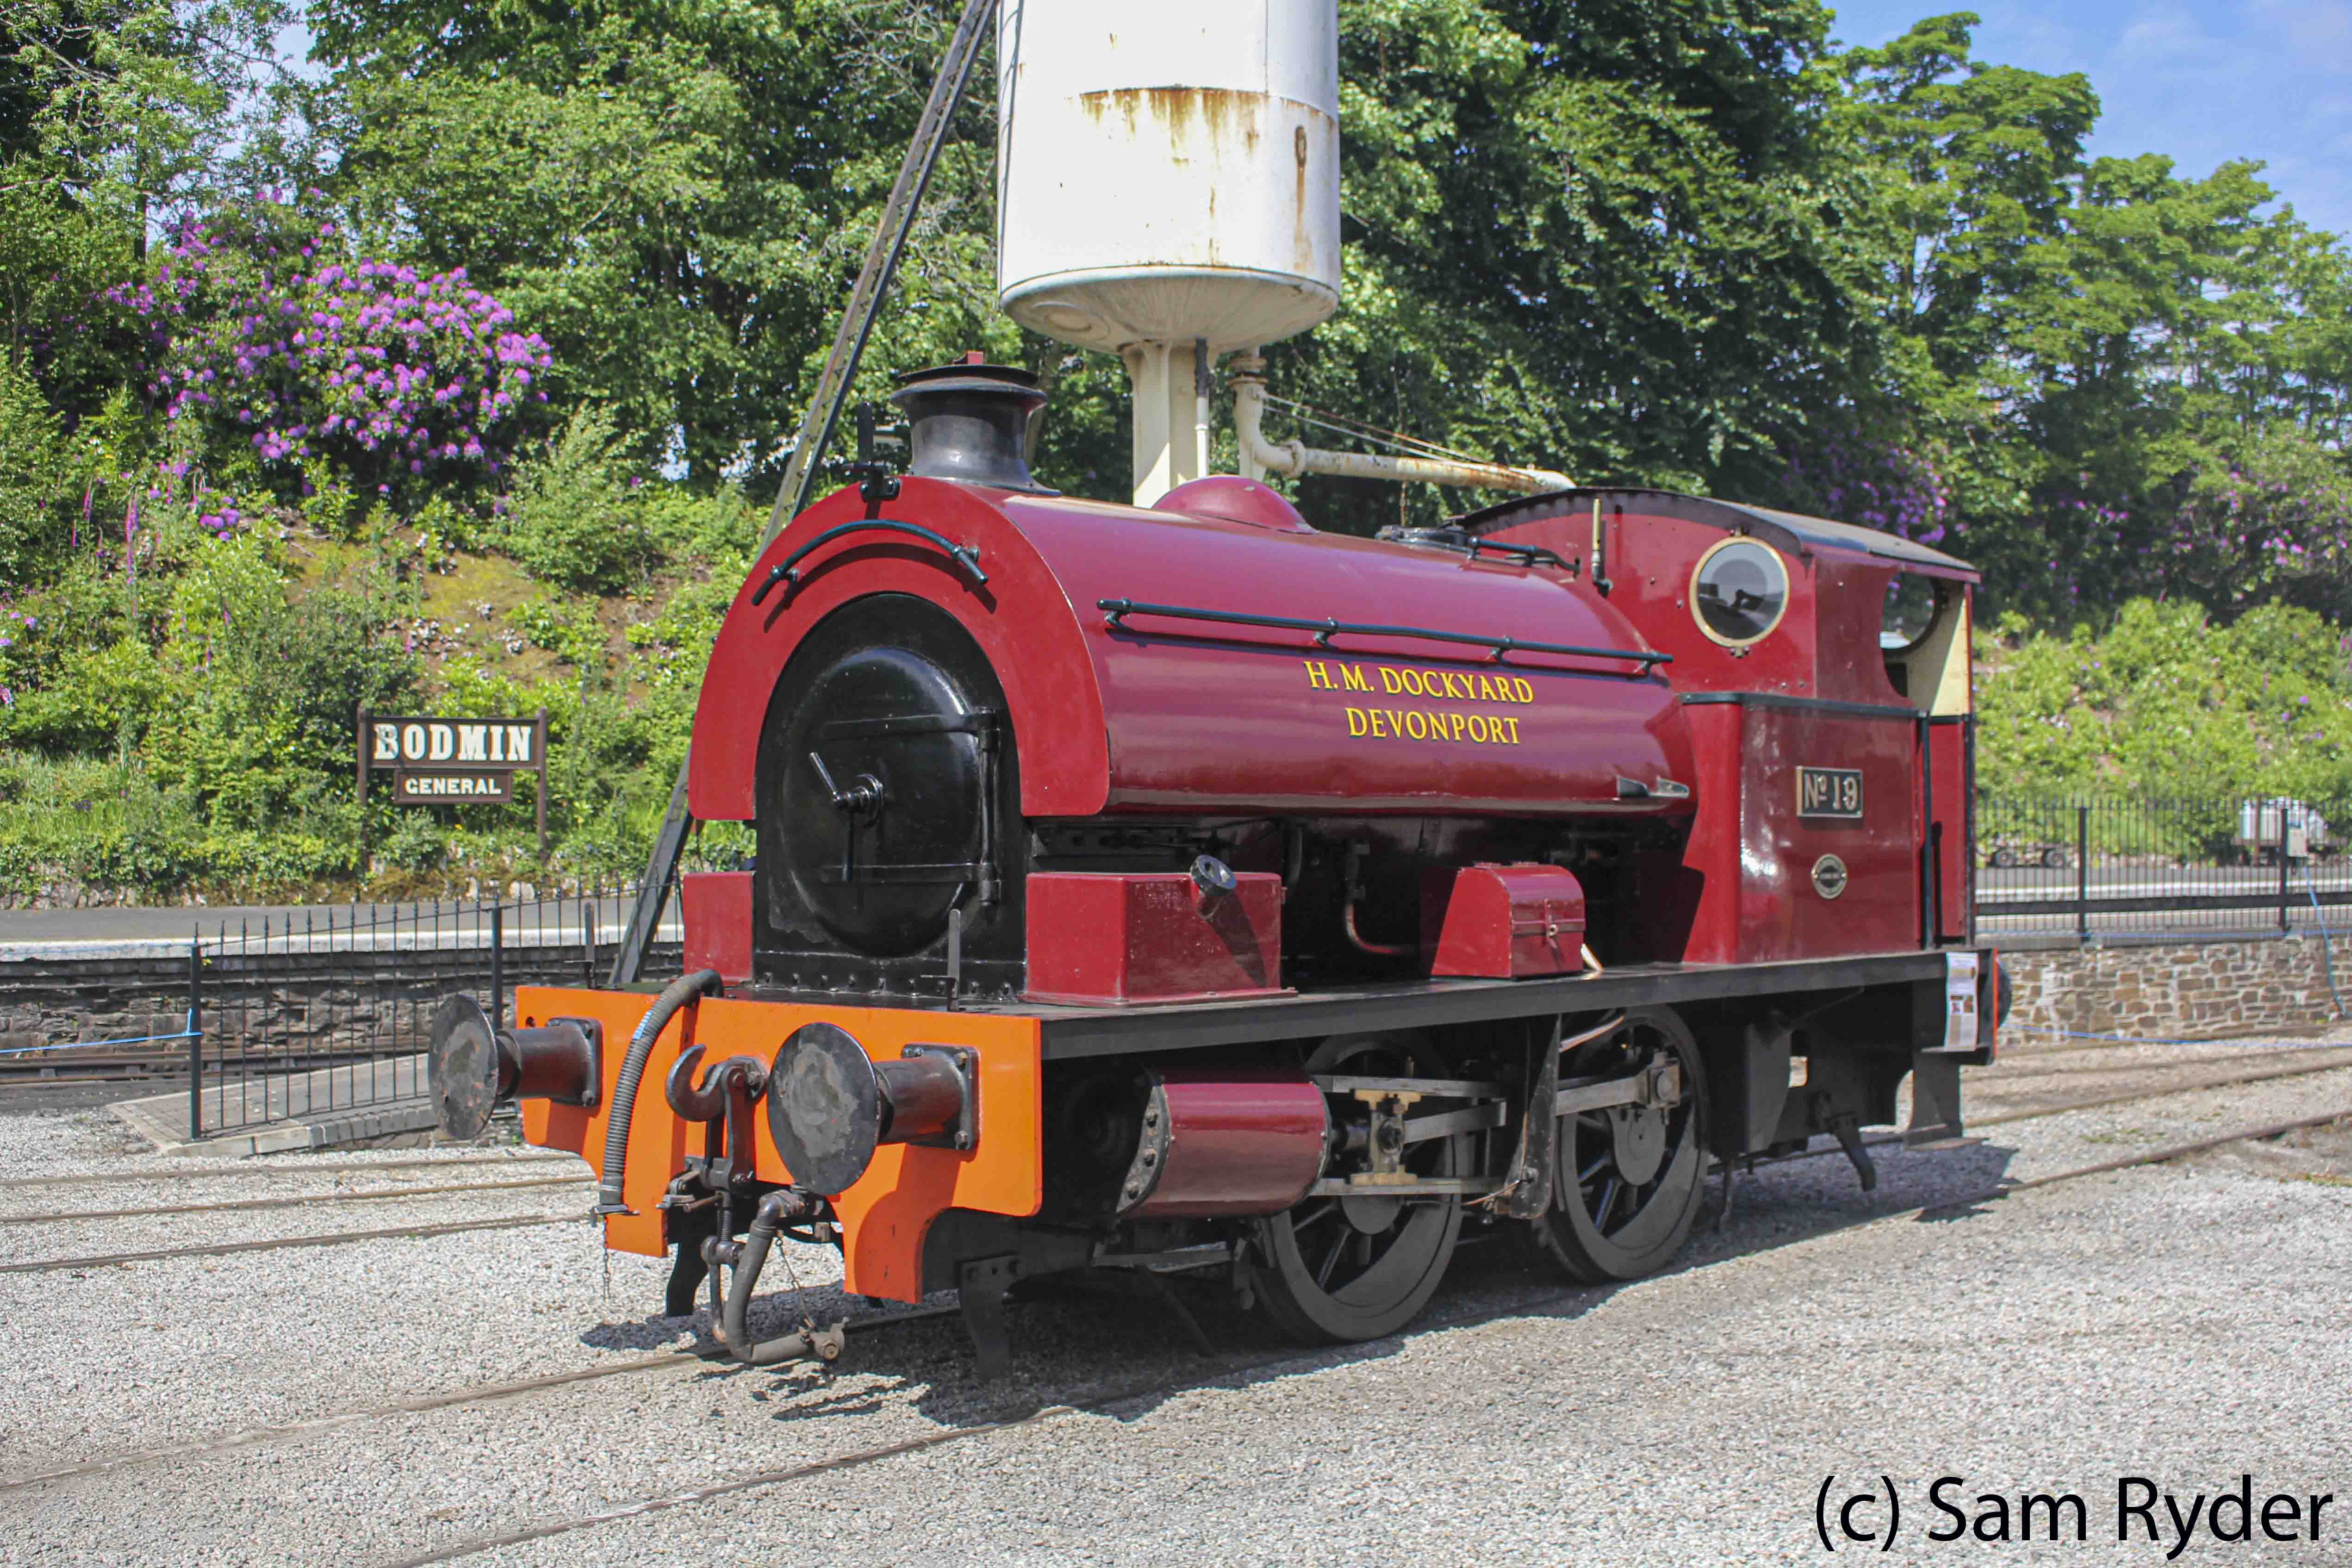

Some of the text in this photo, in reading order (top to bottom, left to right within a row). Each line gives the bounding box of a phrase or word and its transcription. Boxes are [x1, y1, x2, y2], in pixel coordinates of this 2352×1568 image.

[1378, 667, 1534, 703] DOCKYARD
[373, 723, 532, 761] BODMIN
[1345, 708, 1519, 744] DEVONPORT
[404, 778, 502, 795] GENERAL
[1833, 776, 1858, 810] 19
